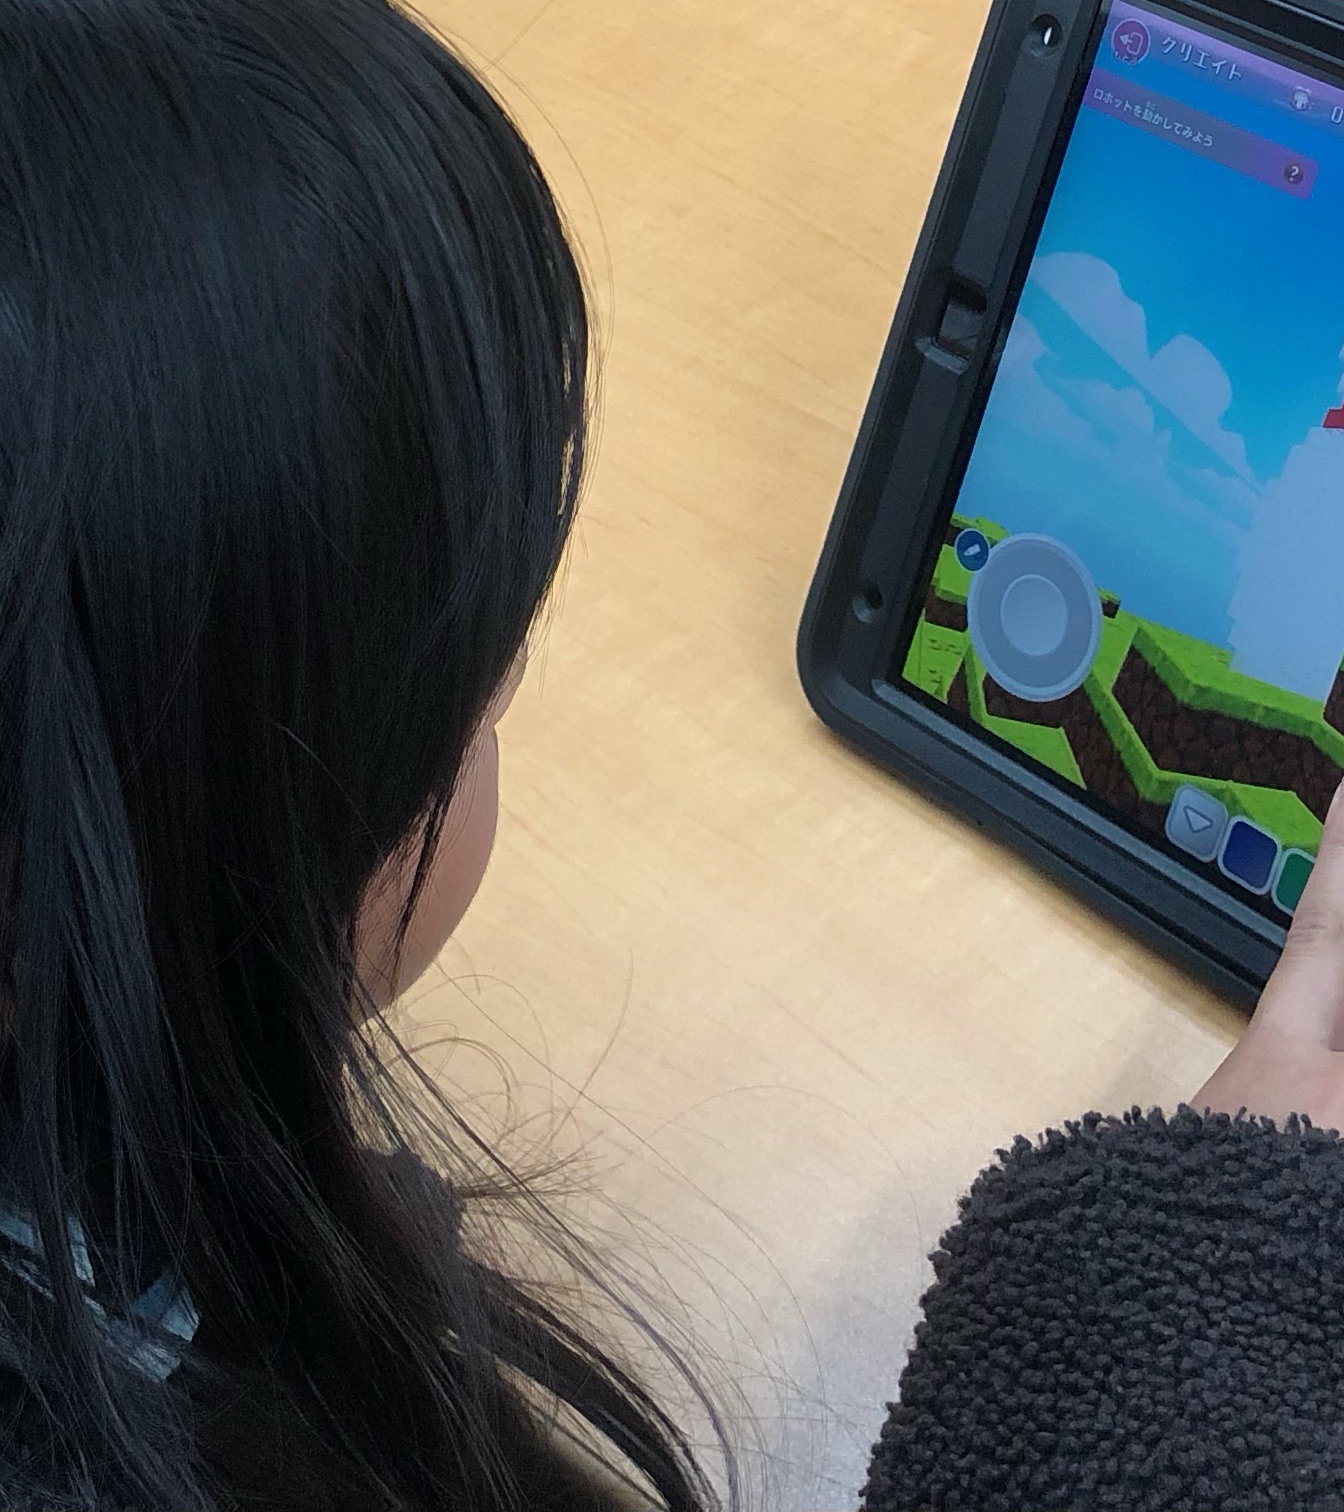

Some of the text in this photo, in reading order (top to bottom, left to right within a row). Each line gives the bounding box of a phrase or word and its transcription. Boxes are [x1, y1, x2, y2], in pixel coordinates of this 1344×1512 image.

[1160, 35, 1242, 81] クリエイト
